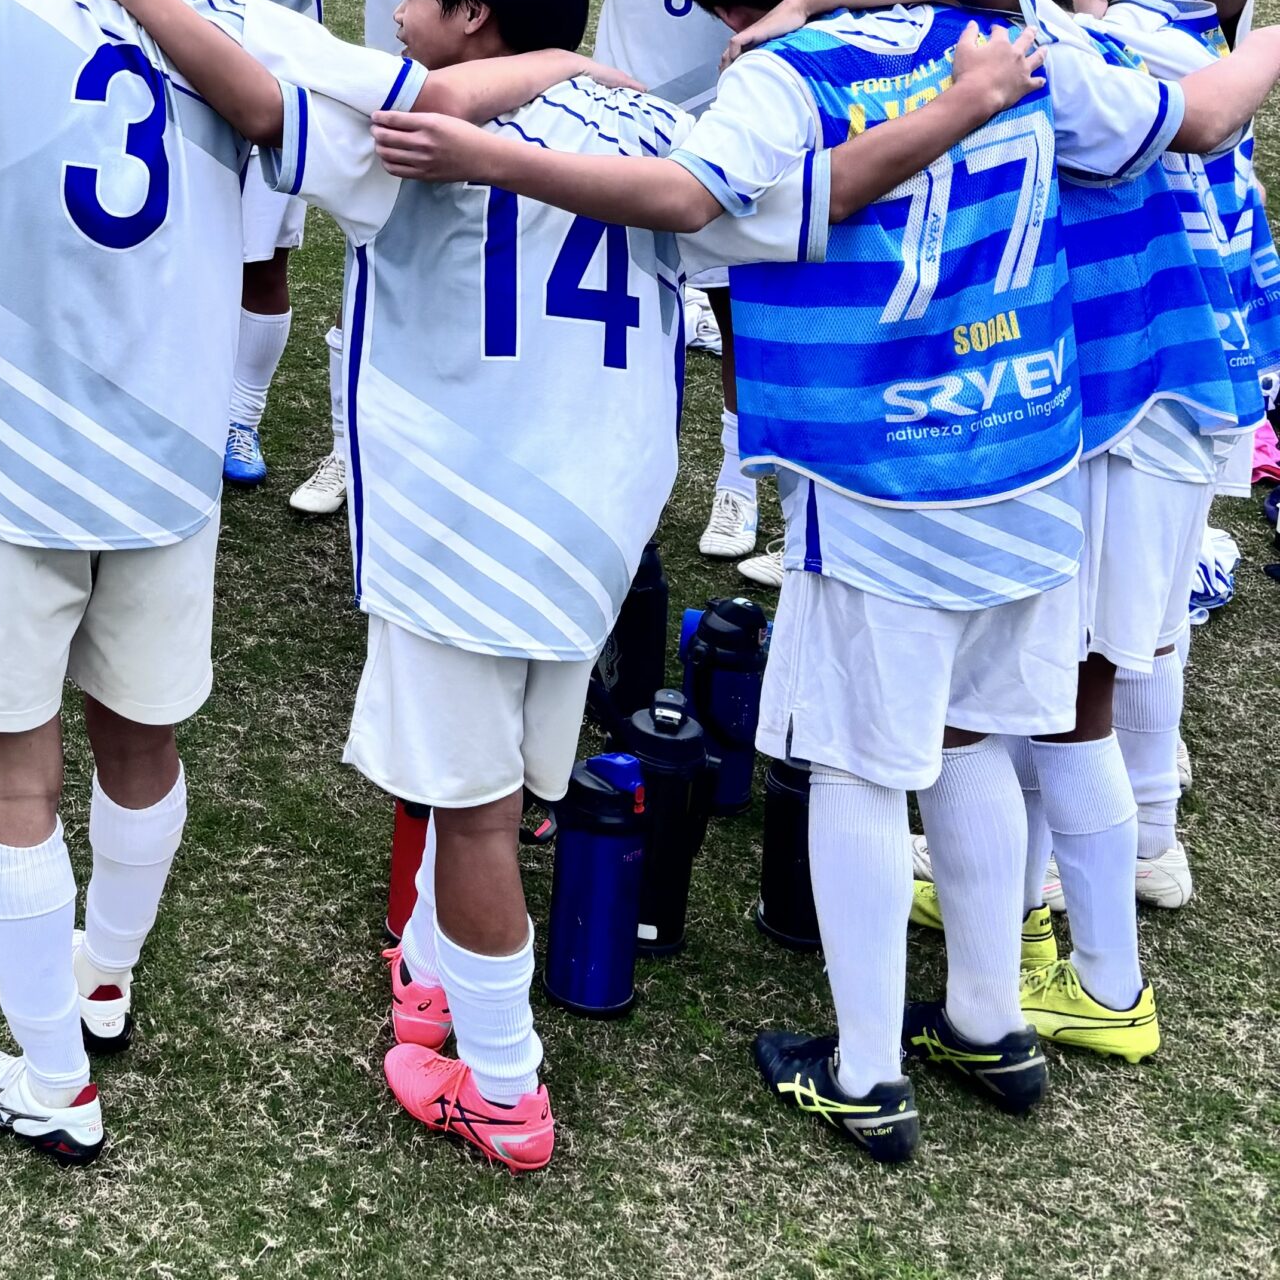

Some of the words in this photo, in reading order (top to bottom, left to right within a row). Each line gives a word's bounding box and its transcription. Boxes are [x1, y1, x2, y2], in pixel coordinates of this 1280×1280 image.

[64, 43, 169, 250] 3
[872, 110, 1055, 324] 77
[464, 181, 640, 370] 14
[886, 423, 963, 443] natureza
[970, 409, 1024, 433] criatura
